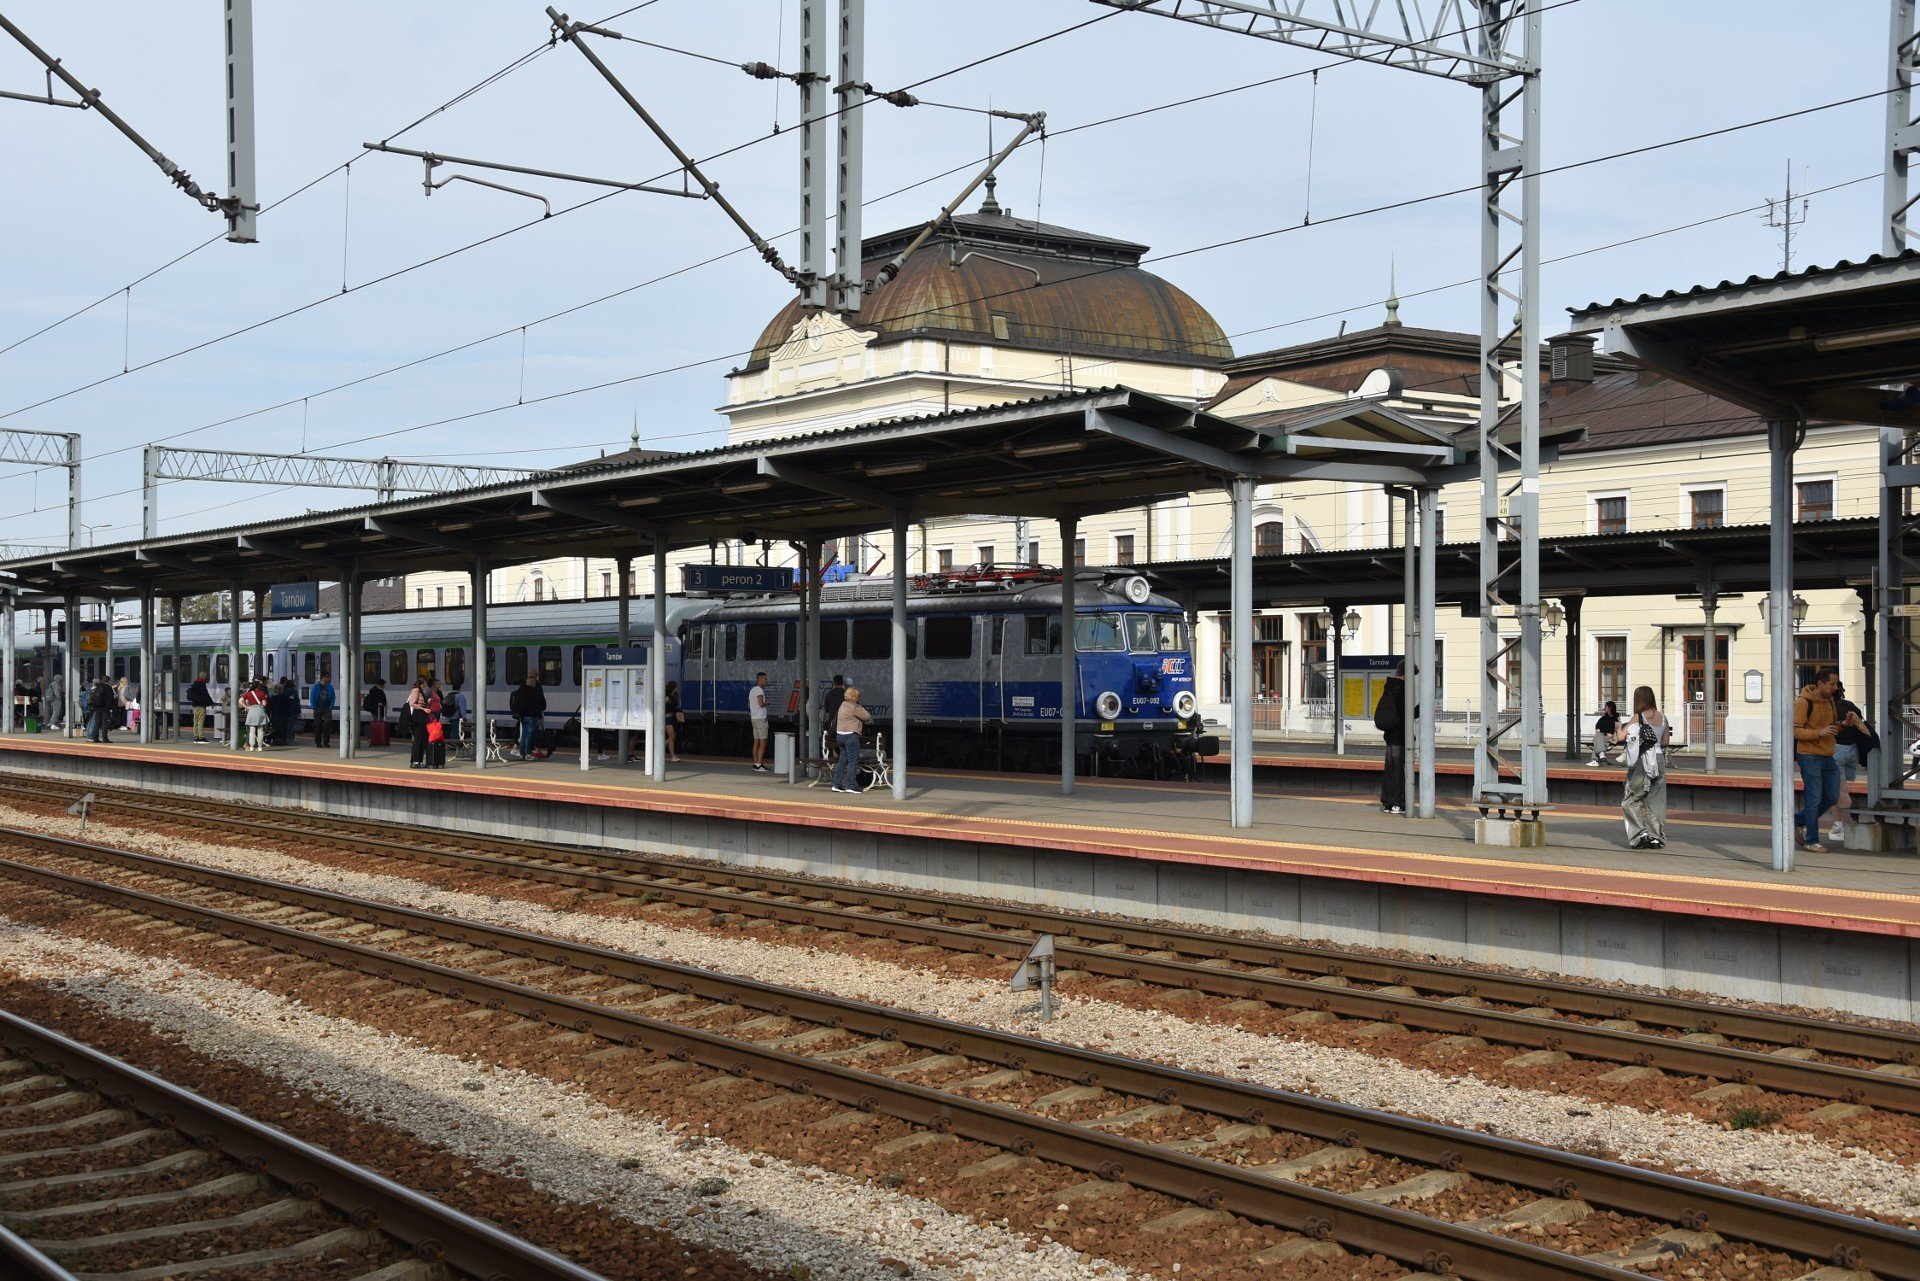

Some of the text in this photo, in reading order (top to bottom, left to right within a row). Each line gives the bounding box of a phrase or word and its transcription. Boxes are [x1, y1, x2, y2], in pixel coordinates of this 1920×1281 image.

[694, 572, 785, 587] 3 peron 2 1
[280, 591, 306, 608] Tarnów
[1368, 658, 1390, 666] Tarnów
[1132, 697, 1160, 705] EU07-092
